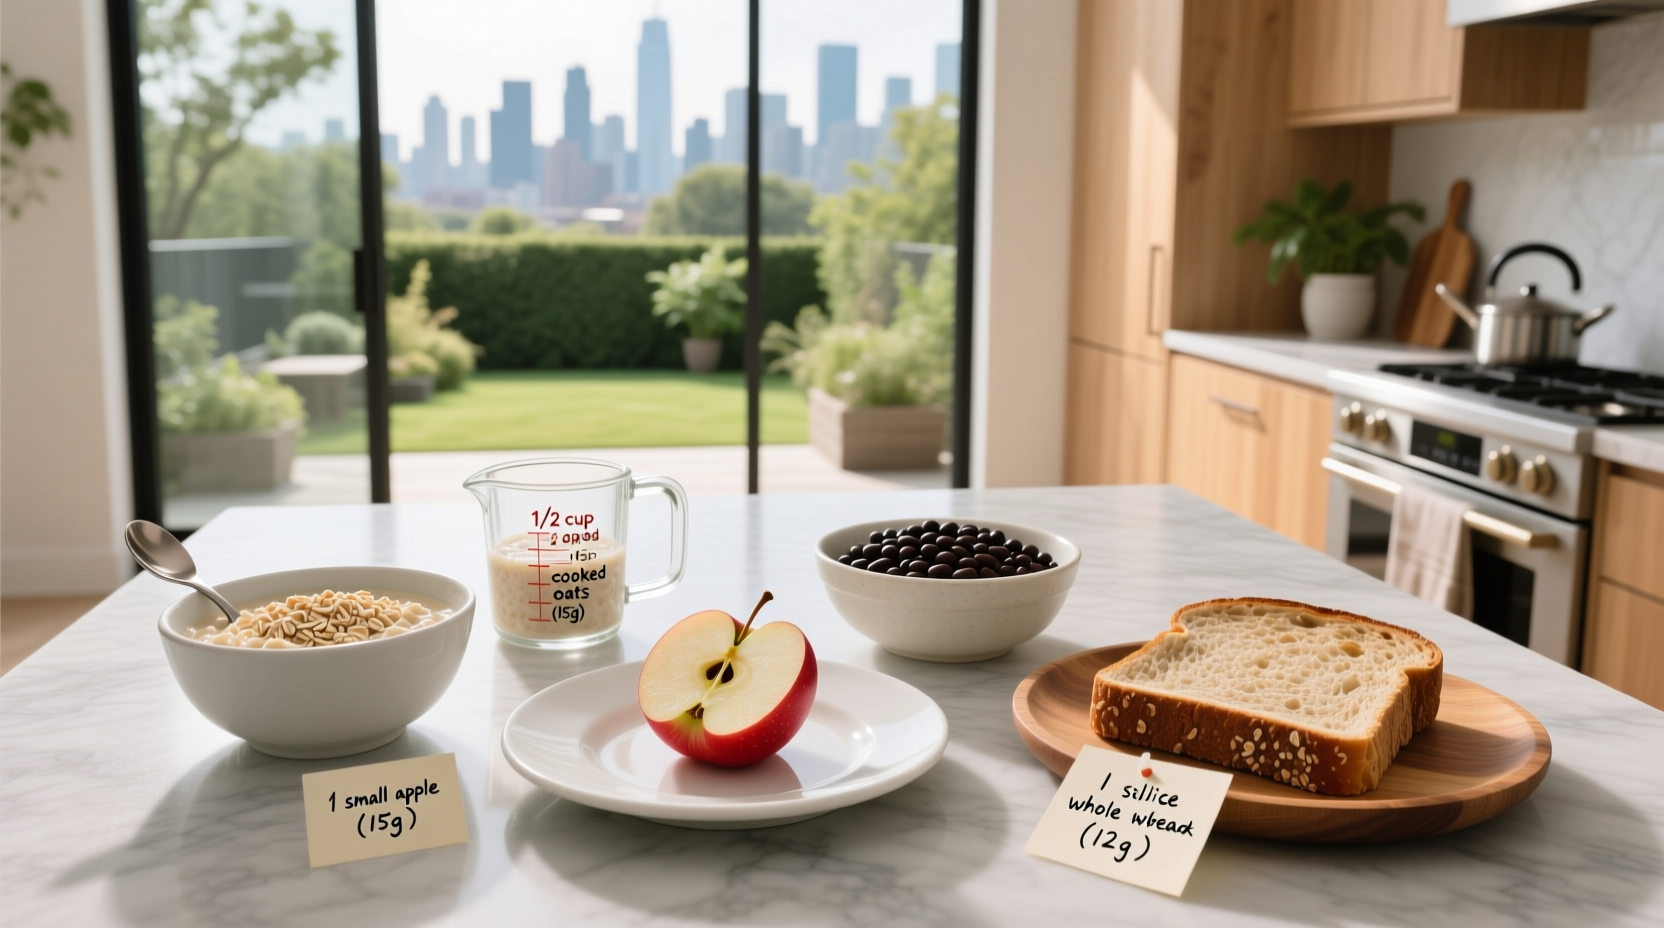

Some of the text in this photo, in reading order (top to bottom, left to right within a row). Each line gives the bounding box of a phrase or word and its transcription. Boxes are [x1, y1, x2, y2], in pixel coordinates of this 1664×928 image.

[531, 506, 594, 530] 1/2 cup
[551, 564, 606, 583] cooked
[553, 586, 590, 600] oats
[552, 603, 585, 624] (15g)
[329, 778, 440, 812] 1 small apple
[1068, 795, 1121, 820] whole
[357, 807, 417, 839] (15g)
[1079, 822, 1151, 863] (12g)
